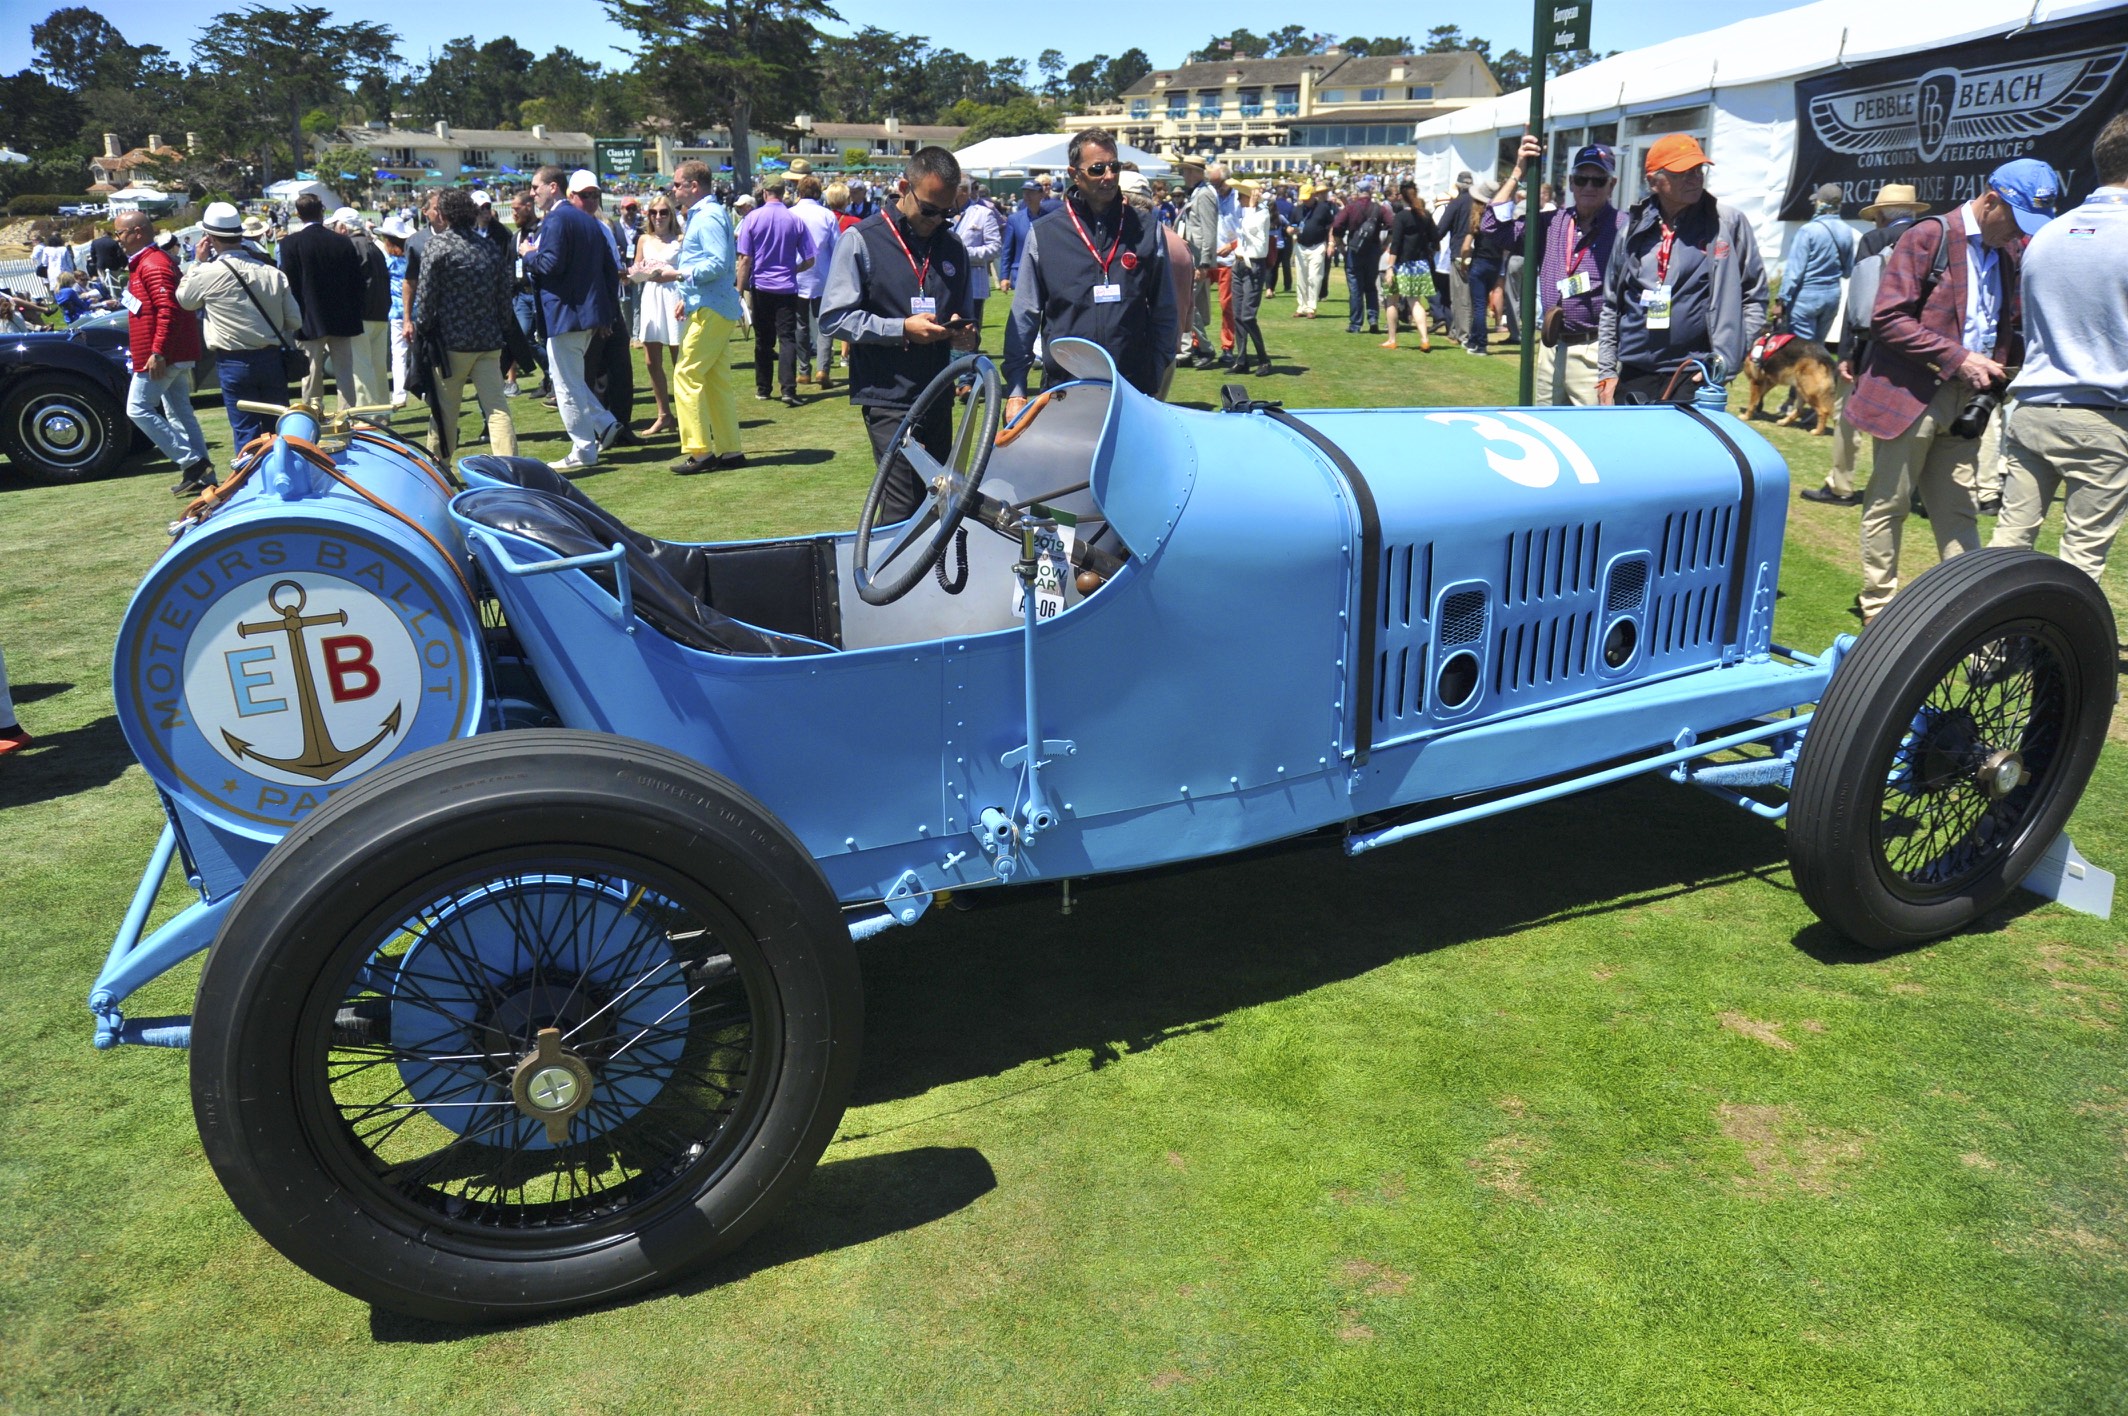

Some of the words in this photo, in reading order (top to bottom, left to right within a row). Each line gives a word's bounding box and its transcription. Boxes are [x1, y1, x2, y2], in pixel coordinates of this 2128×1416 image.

[1854, 93, 1915, 122] PEBBLE
[1958, 73, 2044, 108] BEACH
[606, 148, 624, 158] Class
[1857, 150, 1916, 168] CONCOURS
[1423, 411, 1600, 489] 31
[1033, 534, 1065, 552] 2019
[146, 540, 288, 730] MOTEURS
[316, 540, 454, 699] BALLOT
[224, 645, 289, 718] E
[320, 634, 381, 704] B
